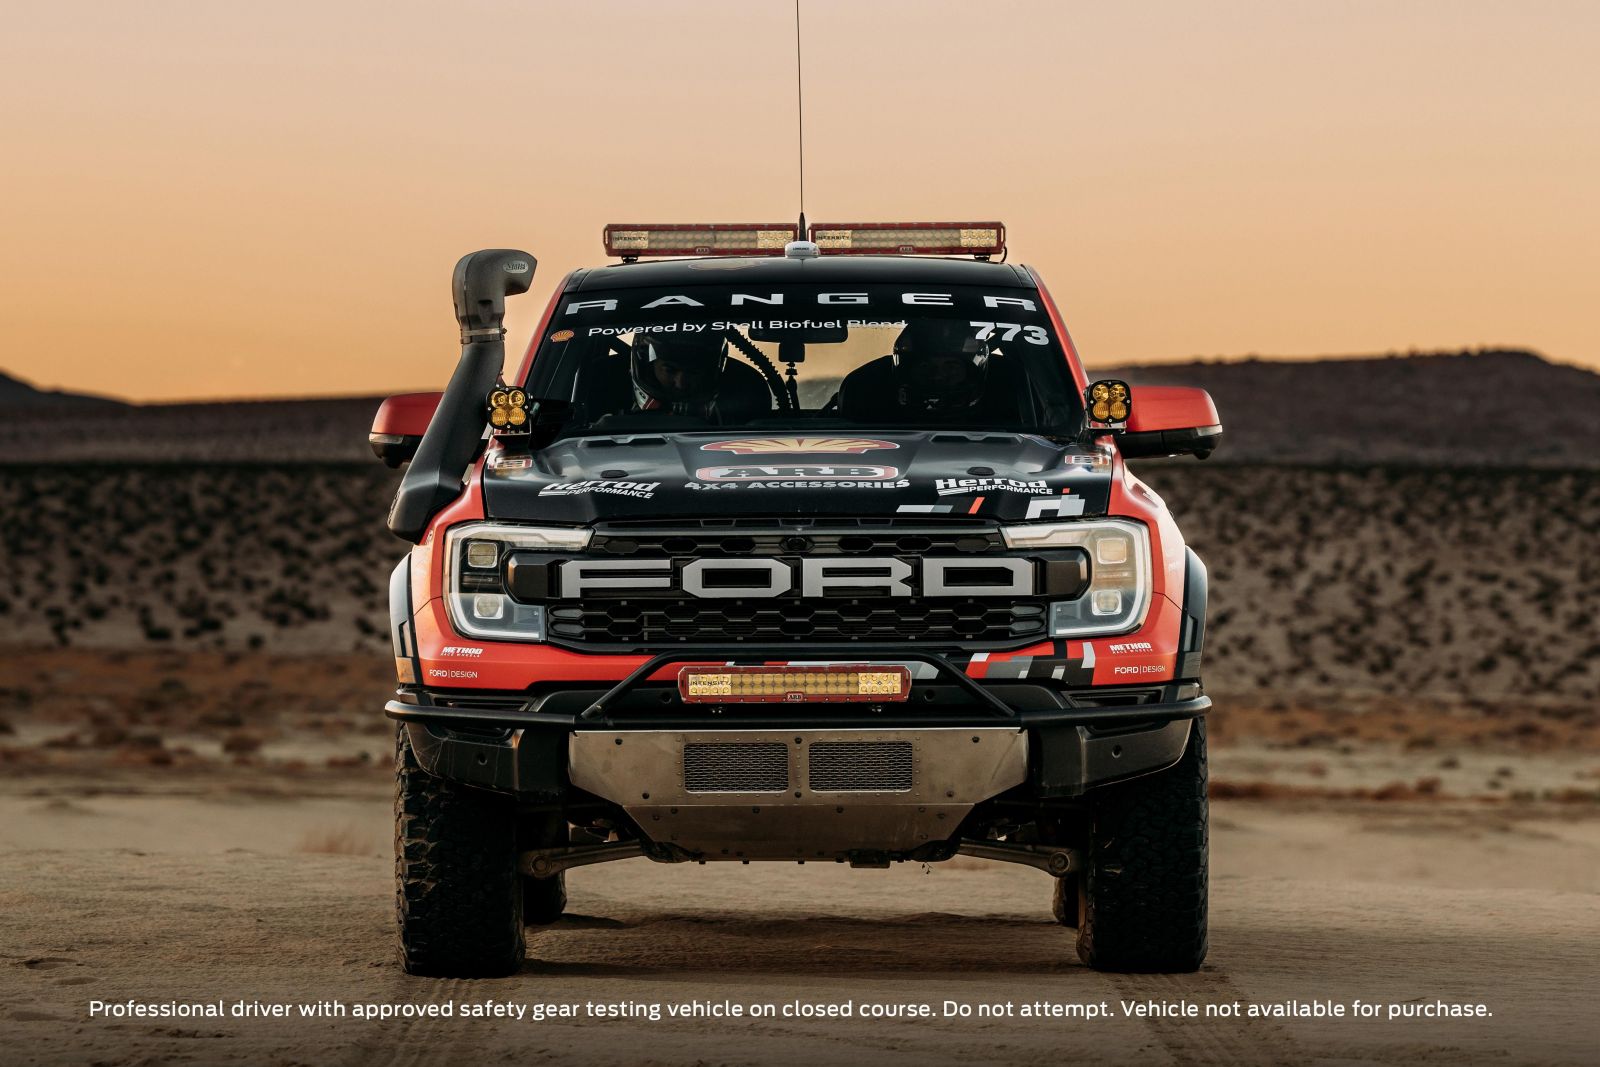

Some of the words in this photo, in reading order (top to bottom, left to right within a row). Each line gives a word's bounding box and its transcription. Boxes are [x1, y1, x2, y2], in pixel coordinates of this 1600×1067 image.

[565, 292, 1038, 315] RANGER
[588, 322, 678, 337] Powered
[682, 322, 707, 333] by
[711, 320, 764, 331] Shell
[769, 319, 842, 330] Biofuel
[969, 321, 1051, 347] 773
[542, 480, 661, 491] Herrod
[683, 481, 738, 491] 4x4
[746, 479, 911, 490] ACCESSORIES
[935, 477, 1048, 490] Herrod
[968, 484, 1054, 495] PERFORMANCE
[566, 486, 655, 499] PERFORMANCE
[559, 557, 1035, 598] FORD
[442, 646, 484, 654] METHOD
[1109, 642, 1152, 651] METHOD
[429, 669, 448, 677] FORD
[450, 670, 478, 678] DESIGN
[1114, 666, 1139, 675] FORD
[1142, 665, 1166, 673] DESIGN
